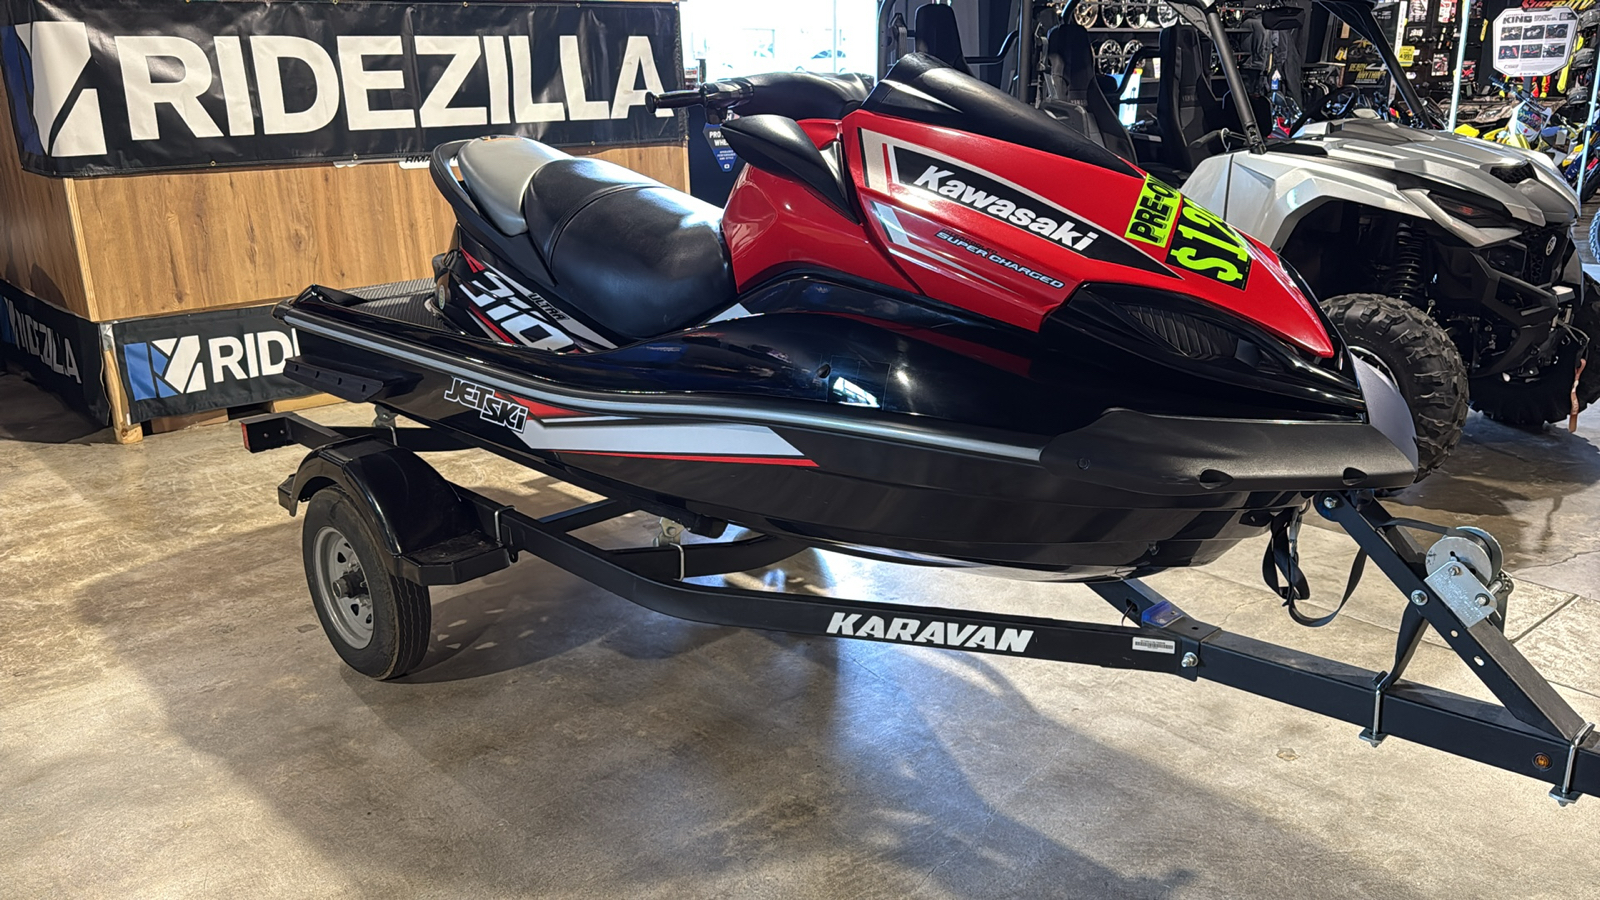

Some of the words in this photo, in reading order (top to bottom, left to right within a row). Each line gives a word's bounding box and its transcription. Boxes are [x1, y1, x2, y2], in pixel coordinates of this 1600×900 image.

[114, 35, 675, 140] RIDEZILLA
[914, 165, 1099, 251] Kawasaki
[1128, 180, 1178, 244] PRE-O
[935, 229, 989, 259] SUPER
[987, 251, 1066, 290] CHARGED
[528, 292, 571, 321] ULTRA
[208, 328, 301, 384] RID
[444, 377, 496, 412] JET
[826, 611, 1034, 653] KARAVAN
